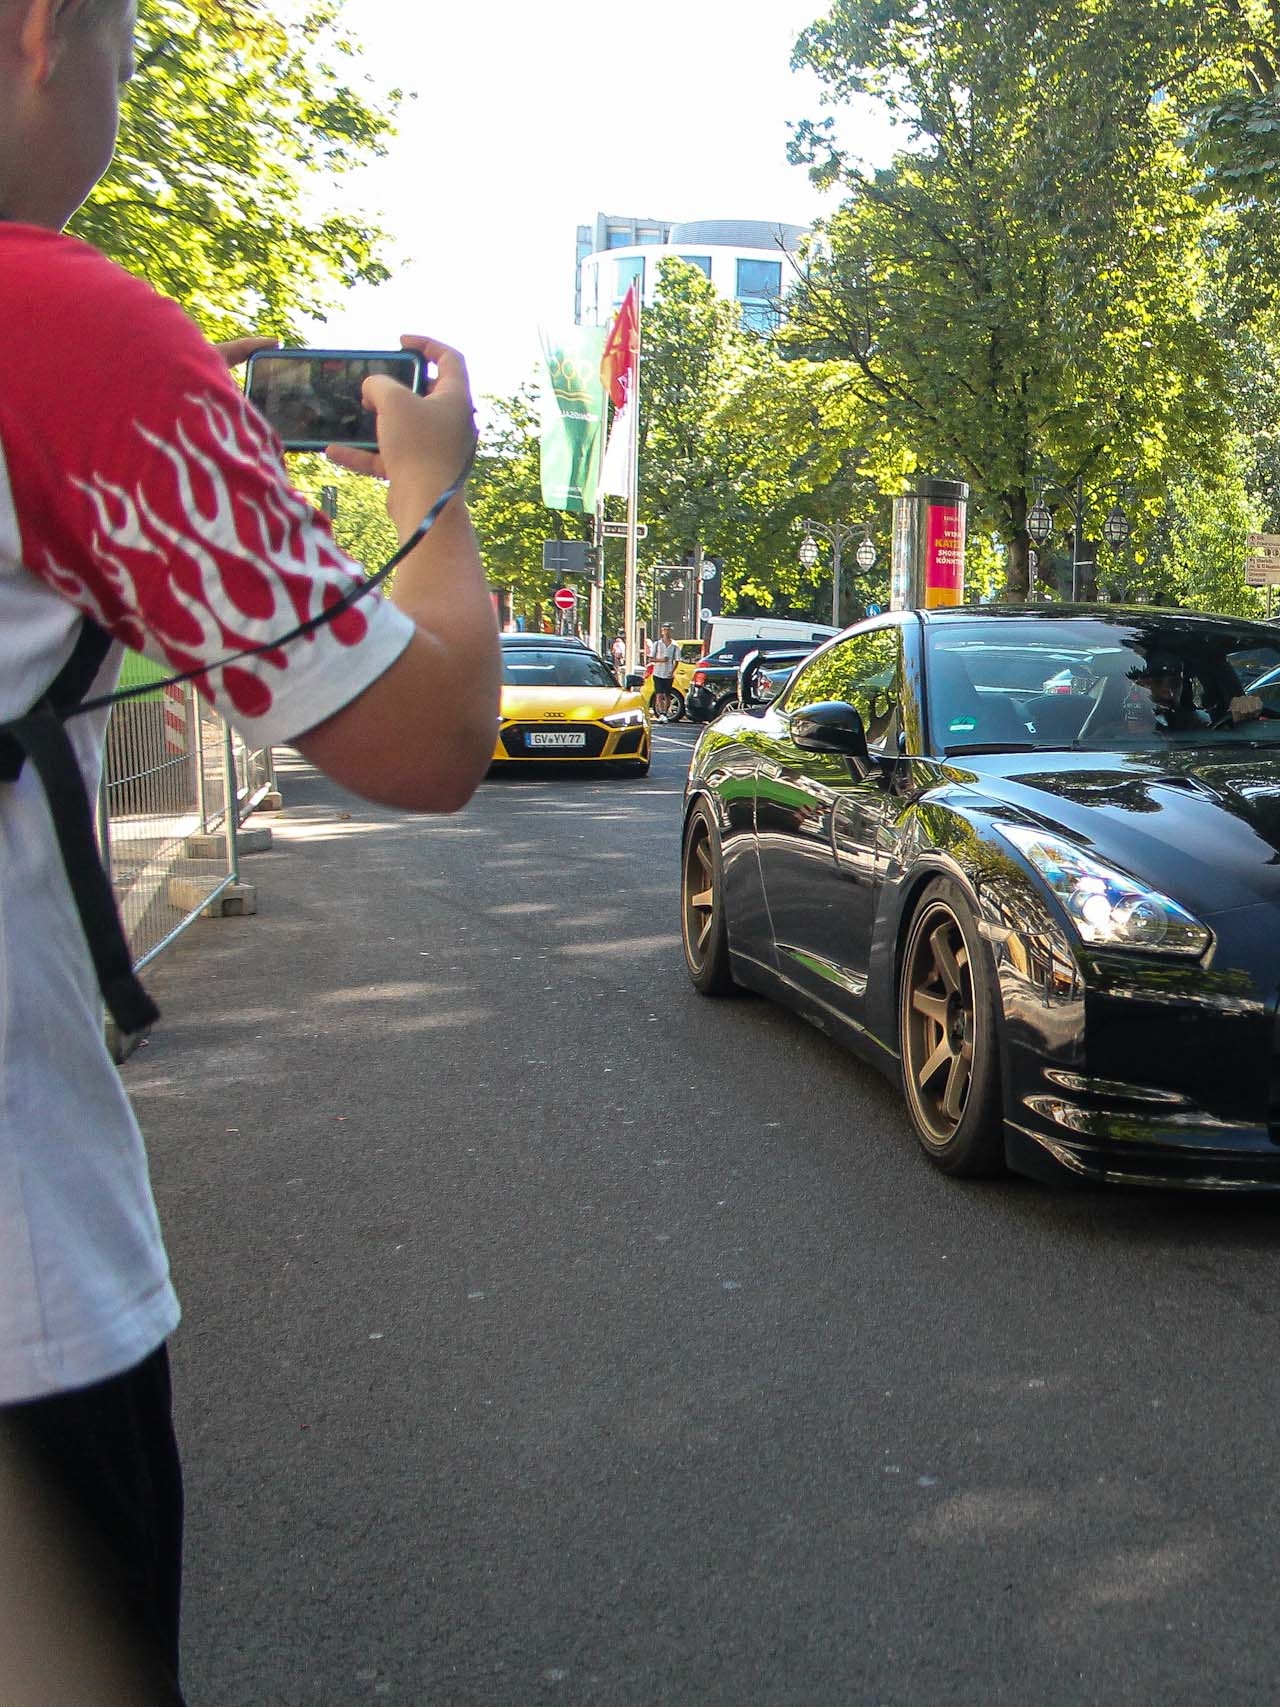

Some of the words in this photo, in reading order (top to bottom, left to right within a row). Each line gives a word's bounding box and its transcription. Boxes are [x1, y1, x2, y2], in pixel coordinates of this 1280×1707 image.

[534, 733, 547, 743] GV
[554, 733, 568, 743] YY
[569, 733, 581, 742] 77
